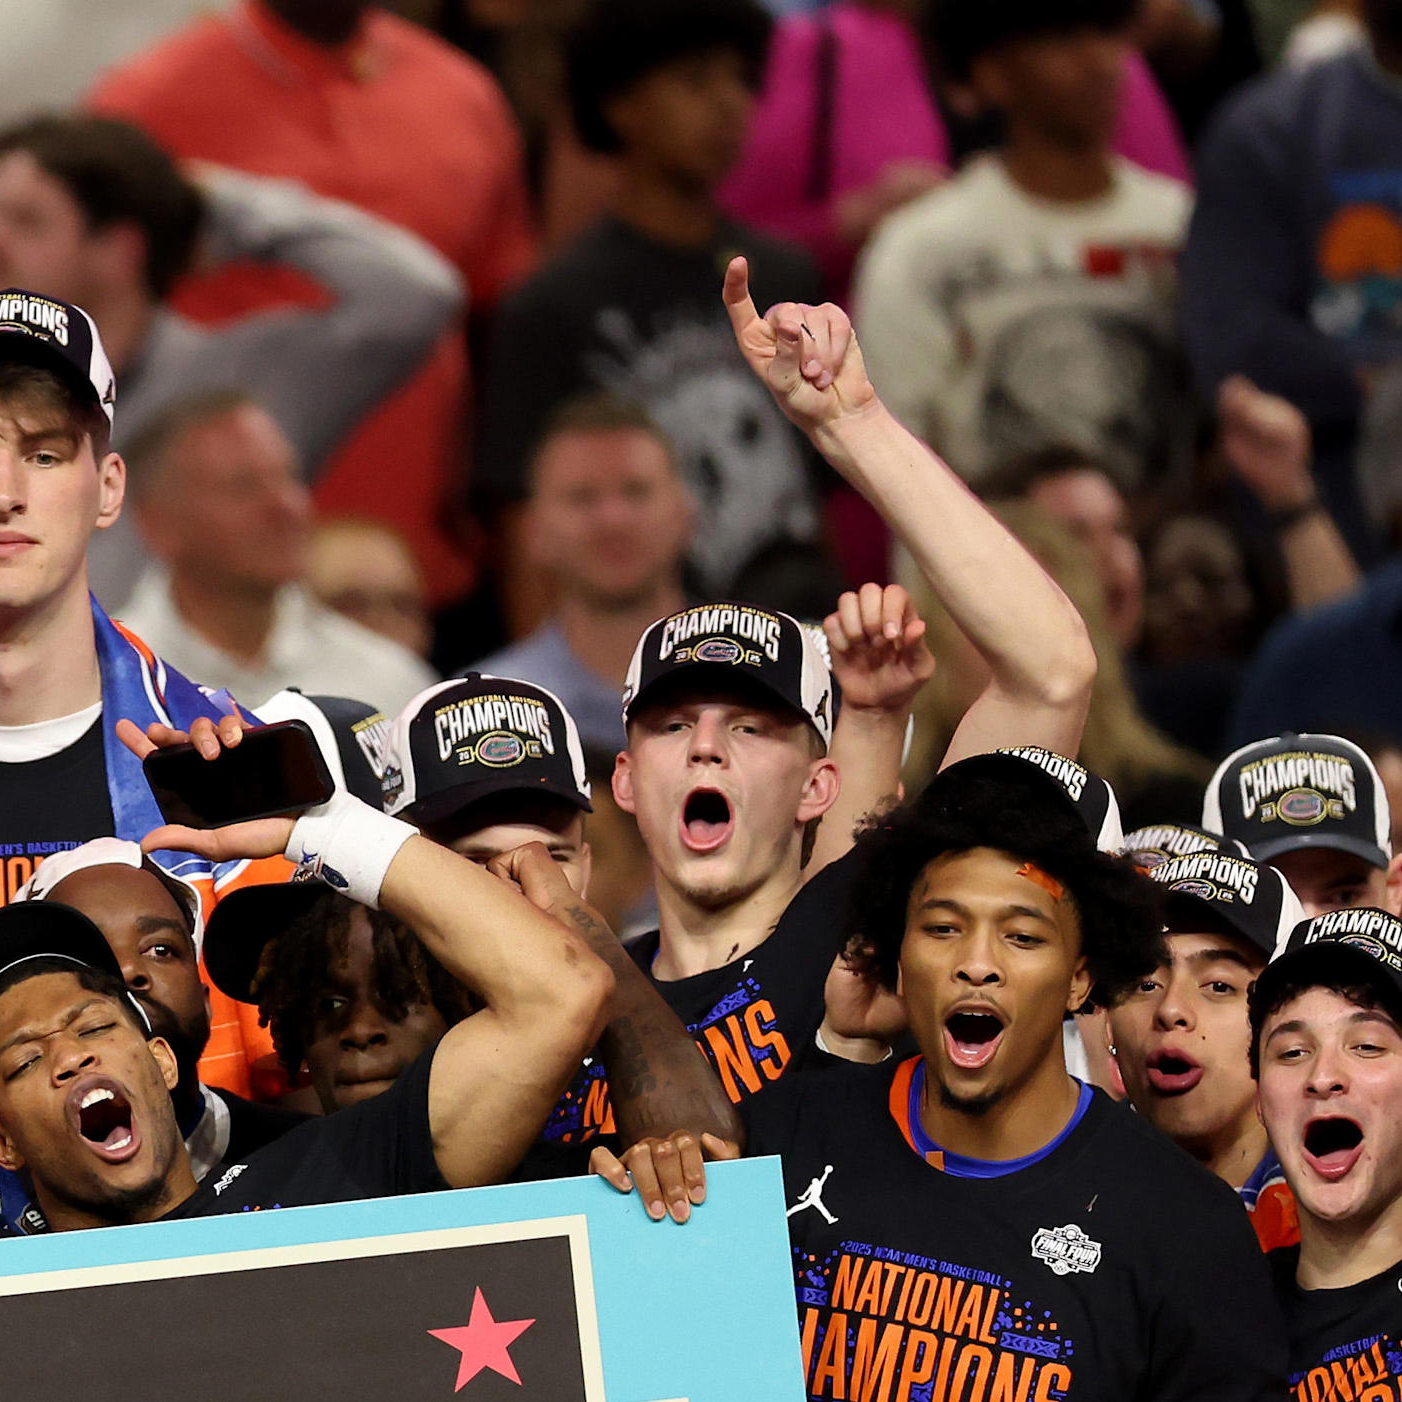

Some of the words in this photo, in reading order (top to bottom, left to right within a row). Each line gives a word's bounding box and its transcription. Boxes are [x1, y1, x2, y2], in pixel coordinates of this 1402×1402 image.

[659, 609, 781, 662] CHAMPIONS
[434, 700, 555, 762] CHAMPIONS
[1240, 758, 1356, 819] CHAMPIONS
[1304, 912, 1402, 952] CHAMPIO
[845, 1240, 872, 1256] 2025
[904, 1252, 937, 1270] MEN'S
[940, 1261, 1001, 1286] BASKETBALL
[1036, 1236, 1068, 1256] FINAL
[1066, 1246, 1097, 1265] FOUR
[831, 1254, 1000, 1345] NATIONAL
